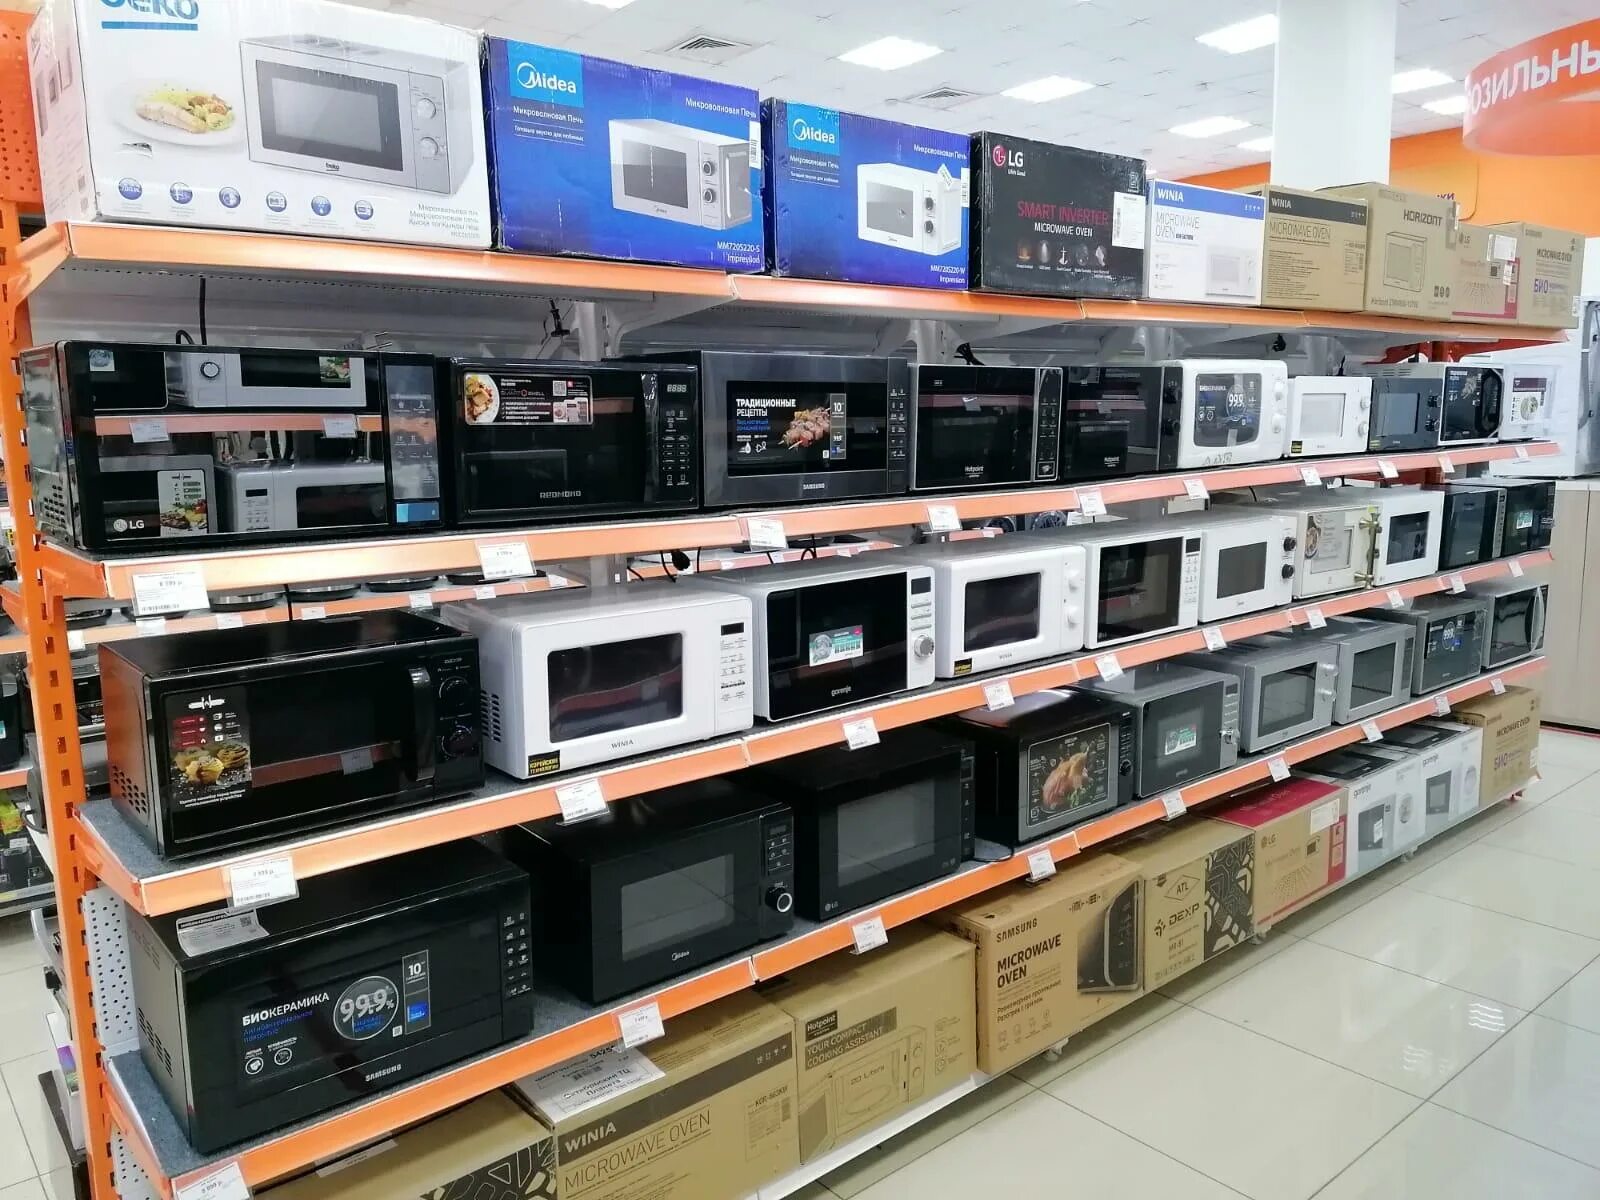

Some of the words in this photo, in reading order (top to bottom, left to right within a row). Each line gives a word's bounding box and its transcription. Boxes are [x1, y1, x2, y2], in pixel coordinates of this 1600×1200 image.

[517, 62, 576, 93] Midea
[513, 106, 566, 121] Микроволновая
[567, 114, 584, 124] Печь
[686, 97, 739, 116] Микроволновая
[740, 107, 757, 118] Печь
[793, 119, 835, 144] Midea
[1009, 150, 1023, 167] LG
[1158, 189, 1184, 203] WINIA
[1271, 198, 1292, 209] WINIA
[1017, 202, 1057, 219] SMART
[1058, 207, 1109, 225] INVERTER
[1155, 210, 1200, 229] MICROWAVE
[1403, 209, 1443, 227] HORIZONT
[1034, 222, 1074, 236] MICROWAVE
[1075, 226, 1093, 238] OVEN
[1155, 224, 1176, 239] OVEN
[1270, 221, 1311, 238] MICROWAVE
[1312, 225, 1331, 240] OVEN
[939, 275, 965, 284] Impression
[1534, 279, 1549, 294] БИО
[735, 398, 796, 409] ТРАДИЦИОННЫЕ
[833, 402, 842, 412] 10
[736, 408, 768, 418] РЕЦЕПТЫ
[964, 465, 984, 475] Hotpoint
[539, 490, 582, 499] REDMOND
[129, 520, 145, 531] LG
[831, 685, 851, 697] gorenje
[611, 738, 634, 749] WINIA
[1168, 903, 1200, 923] DEXP
[996, 918, 1038, 943] SAMSUNG
[671, 950, 690, 961] Midea
[997, 934, 1062, 973] MICROWAVE
[408, 963, 422, 976] 10
[997, 964, 1027, 988] OVEN
[242, 992, 330, 1027] БИОКЕРАМИКА
[807, 1014, 836, 1032] Hotpoint
[807, 1047, 844, 1068] COOKING
[844, 1027, 884, 1050] ASSISTANT
[808, 1037, 830, 1056] YOUR
[830, 1023, 867, 1048] COMPACT
[365, 1064, 402, 1082] SAMSUNG
[618, 1067, 632, 1078] ТЦ
[564, 1121, 617, 1153] WINIA
[565, 1131, 666, 1193] MICROWAVE
[669, 1109, 711, 1142] OVEN
